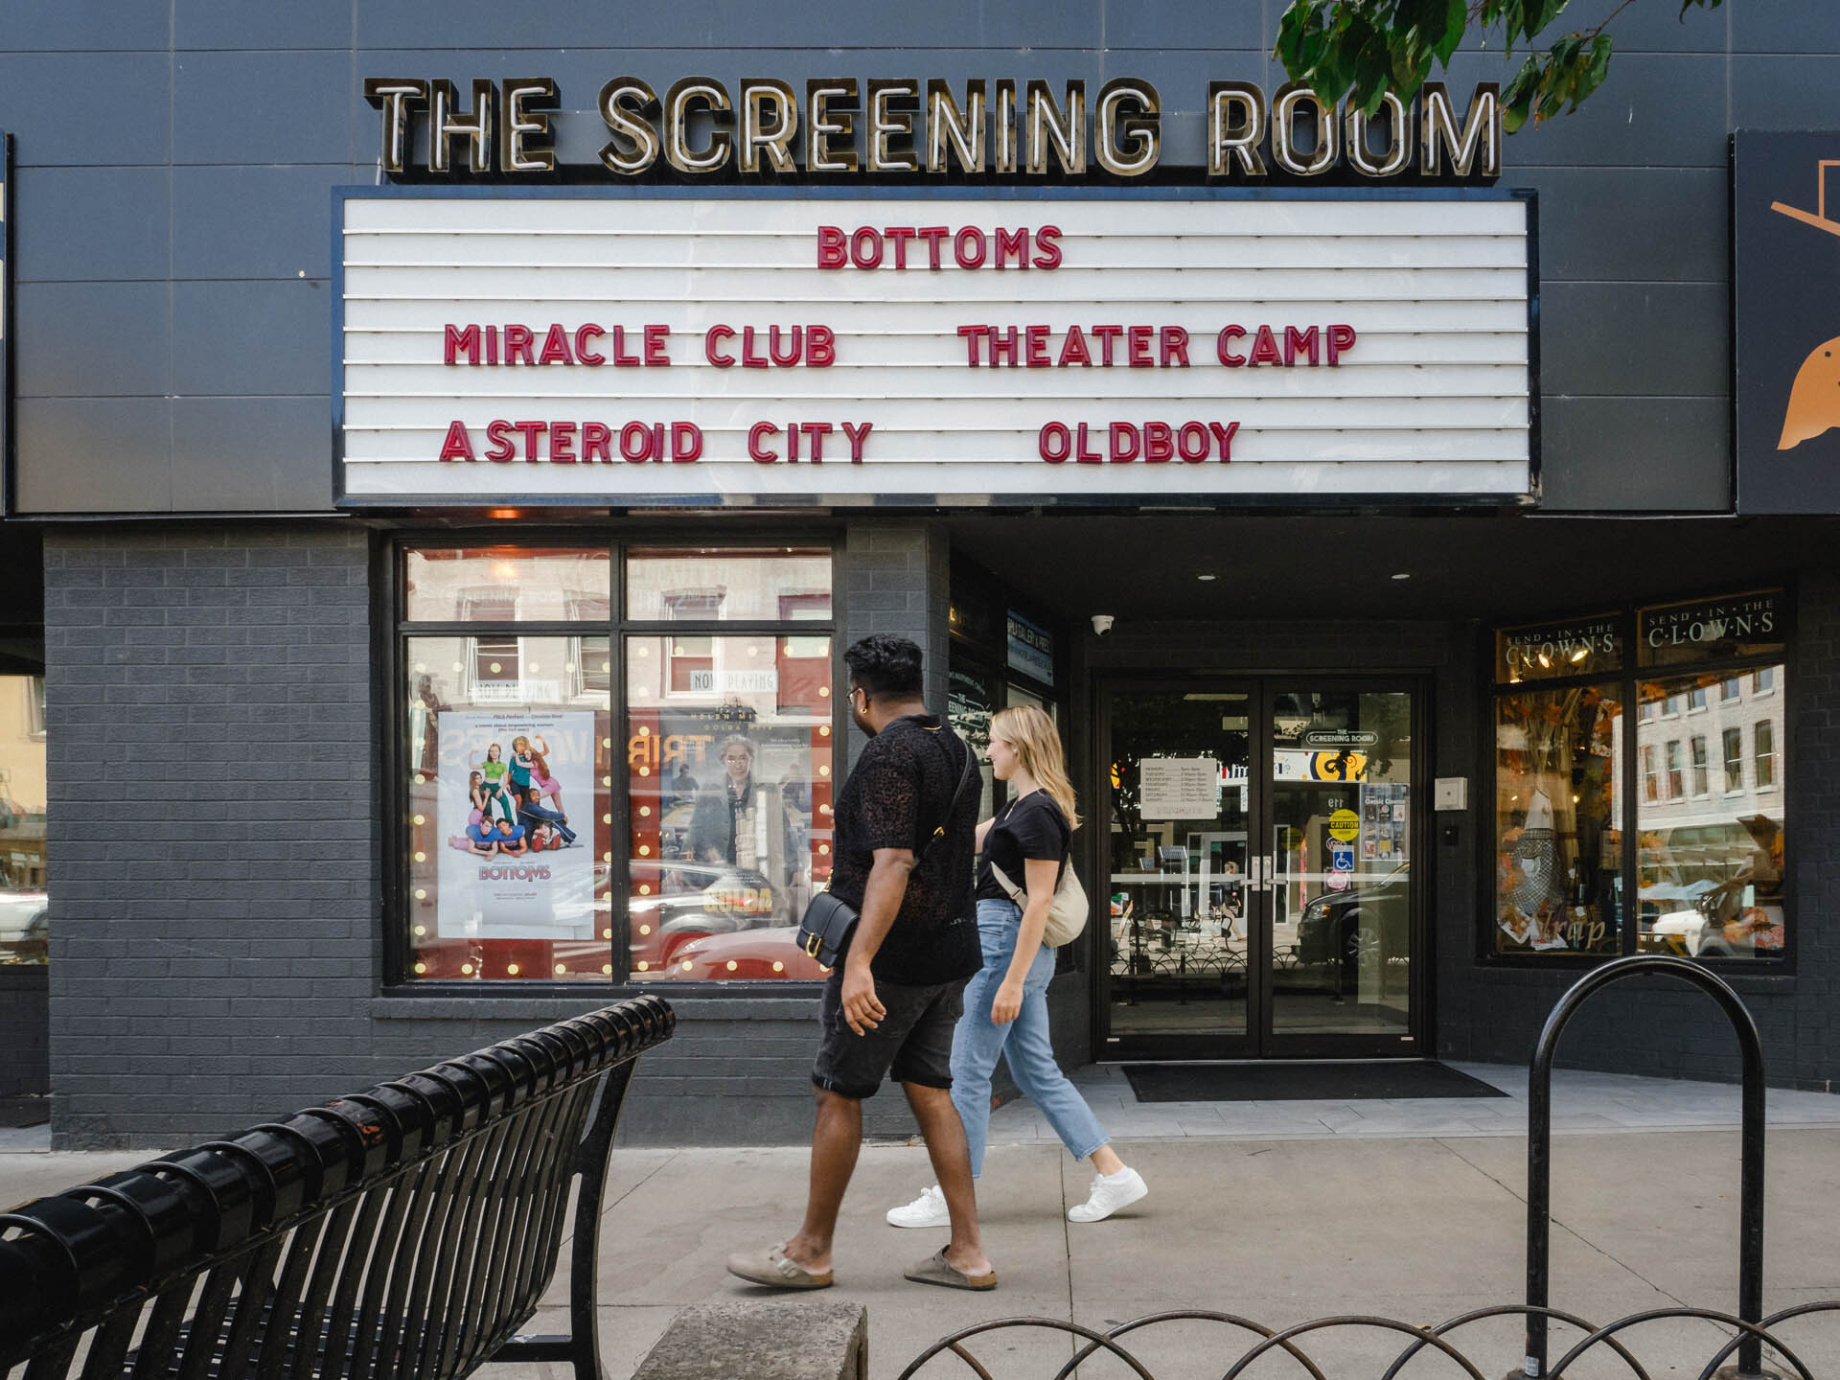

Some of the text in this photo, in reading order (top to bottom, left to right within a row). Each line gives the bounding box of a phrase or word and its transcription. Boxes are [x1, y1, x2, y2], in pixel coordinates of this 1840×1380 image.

[364, 76, 1501, 182] THE SCREENING ROOM
[817, 225, 1063, 271] BOTTOMS
[444, 323, 836, 369] MIRACLE CLUB
[957, 324, 1357, 369] THEATER CAMP
[439, 420, 873, 465] ASTEROID CITY
[1038, 421, 1240, 465] OLDBOY
[1649, 600, 1773, 626] SEND IN THE
[1507, 624, 1614, 646] SEND IN THE
[1310, 735, 1374, 743] SCREENING ROOM
[1330, 821, 1359, 829] CAUTION
[478, 864, 552, 882] BOTTOMS
[703, 887, 773, 913] GOLDA
